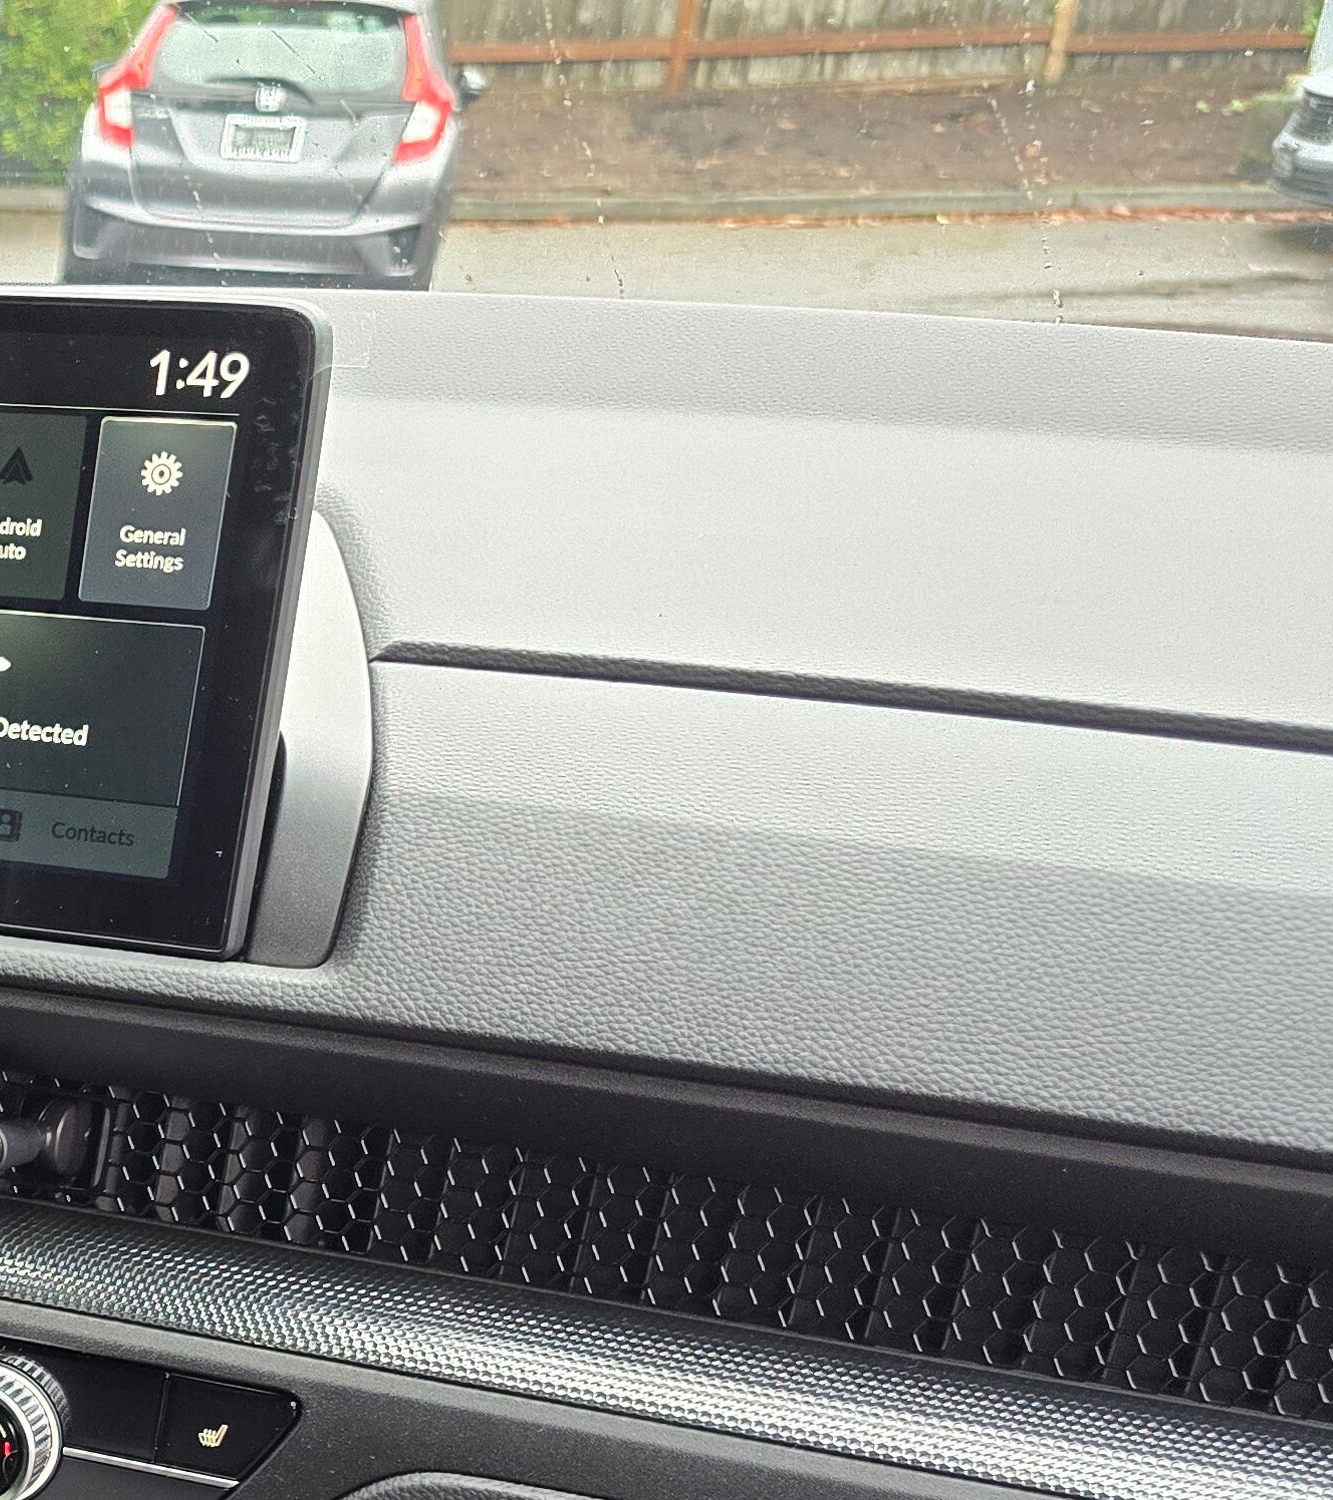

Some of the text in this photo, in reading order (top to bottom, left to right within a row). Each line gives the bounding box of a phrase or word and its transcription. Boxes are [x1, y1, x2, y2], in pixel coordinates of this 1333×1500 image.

[147, 349, 250, 399] 1:49
[119, 524, 187, 547] General
[114, 548, 184, 574] Settings
[50, 819, 135, 849] Contacts
